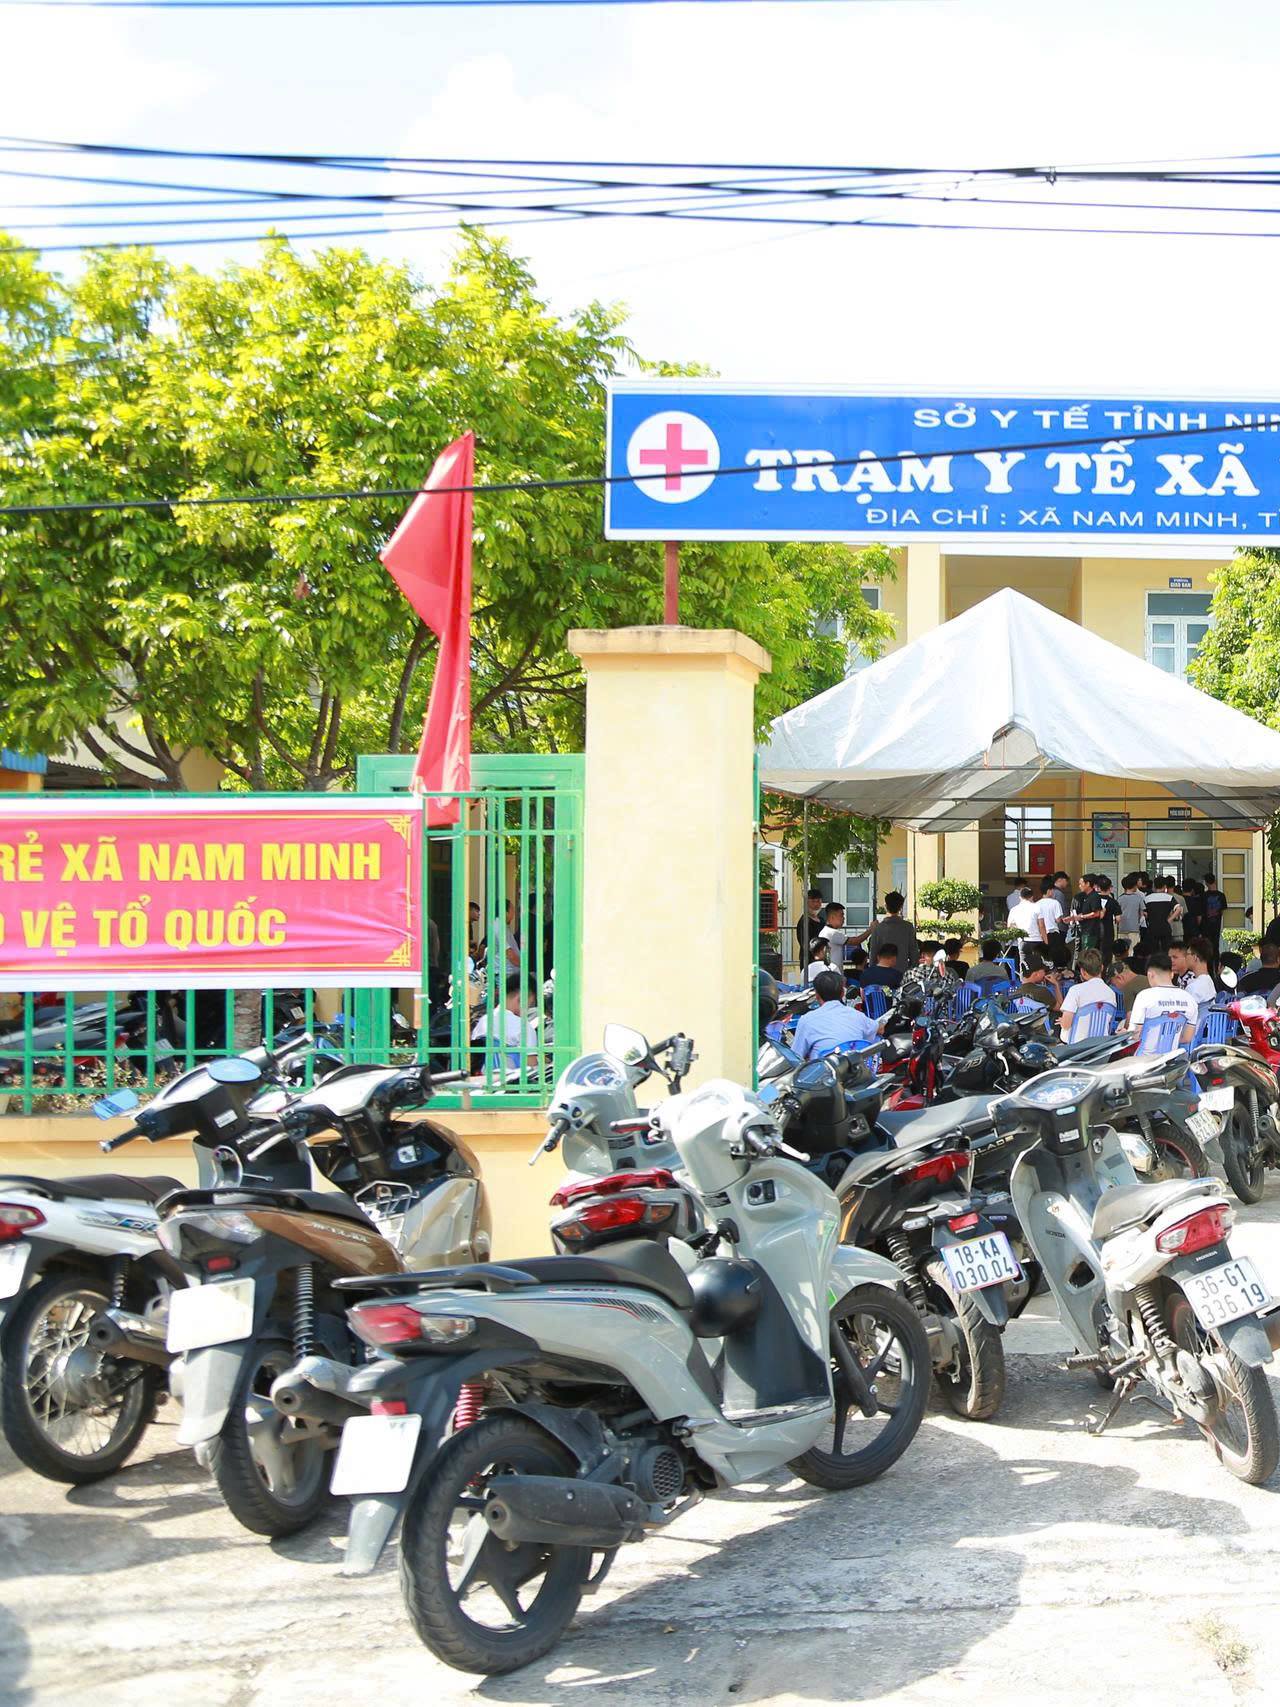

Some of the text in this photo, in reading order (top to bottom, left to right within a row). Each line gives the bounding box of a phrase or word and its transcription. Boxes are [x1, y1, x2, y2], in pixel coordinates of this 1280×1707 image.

[914, 403, 976, 429] SỞ
[990, 410, 1018, 429] Y
[1033, 403, 1090, 430] TẾ
[1104, 403, 1208, 432] TỈNH
[745, 449, 954, 505] TRẠM
[975, 451, 1025, 494] Y
[1045, 439, 1136, 496] TẾ
[1155, 442, 1260, 498] XÃ
[866, 508, 921, 527] ĐỊA
[932, 505, 989, 526] CHỈ
[1018, 506, 1060, 527] XÃ
[1073, 511, 1144, 528] NAM
[1155, 511, 1247, 531] MINH,
[60, 835, 123, 882] XÃ
[138, 843, 245, 881] NAM
[261, 842, 381, 881] MINH
[21, 901, 77, 957] VỆ
[93, 894, 152, 949] TỔ
[164, 896, 288, 952] QUỐC
[954, 1237, 1001, 1266] 18-KA
[955, 1256, 1014, 1289] 030.04
[1195, 1263, 1248, 1299] 36-G1
[1201, 1283, 1265, 1324] 336.19
